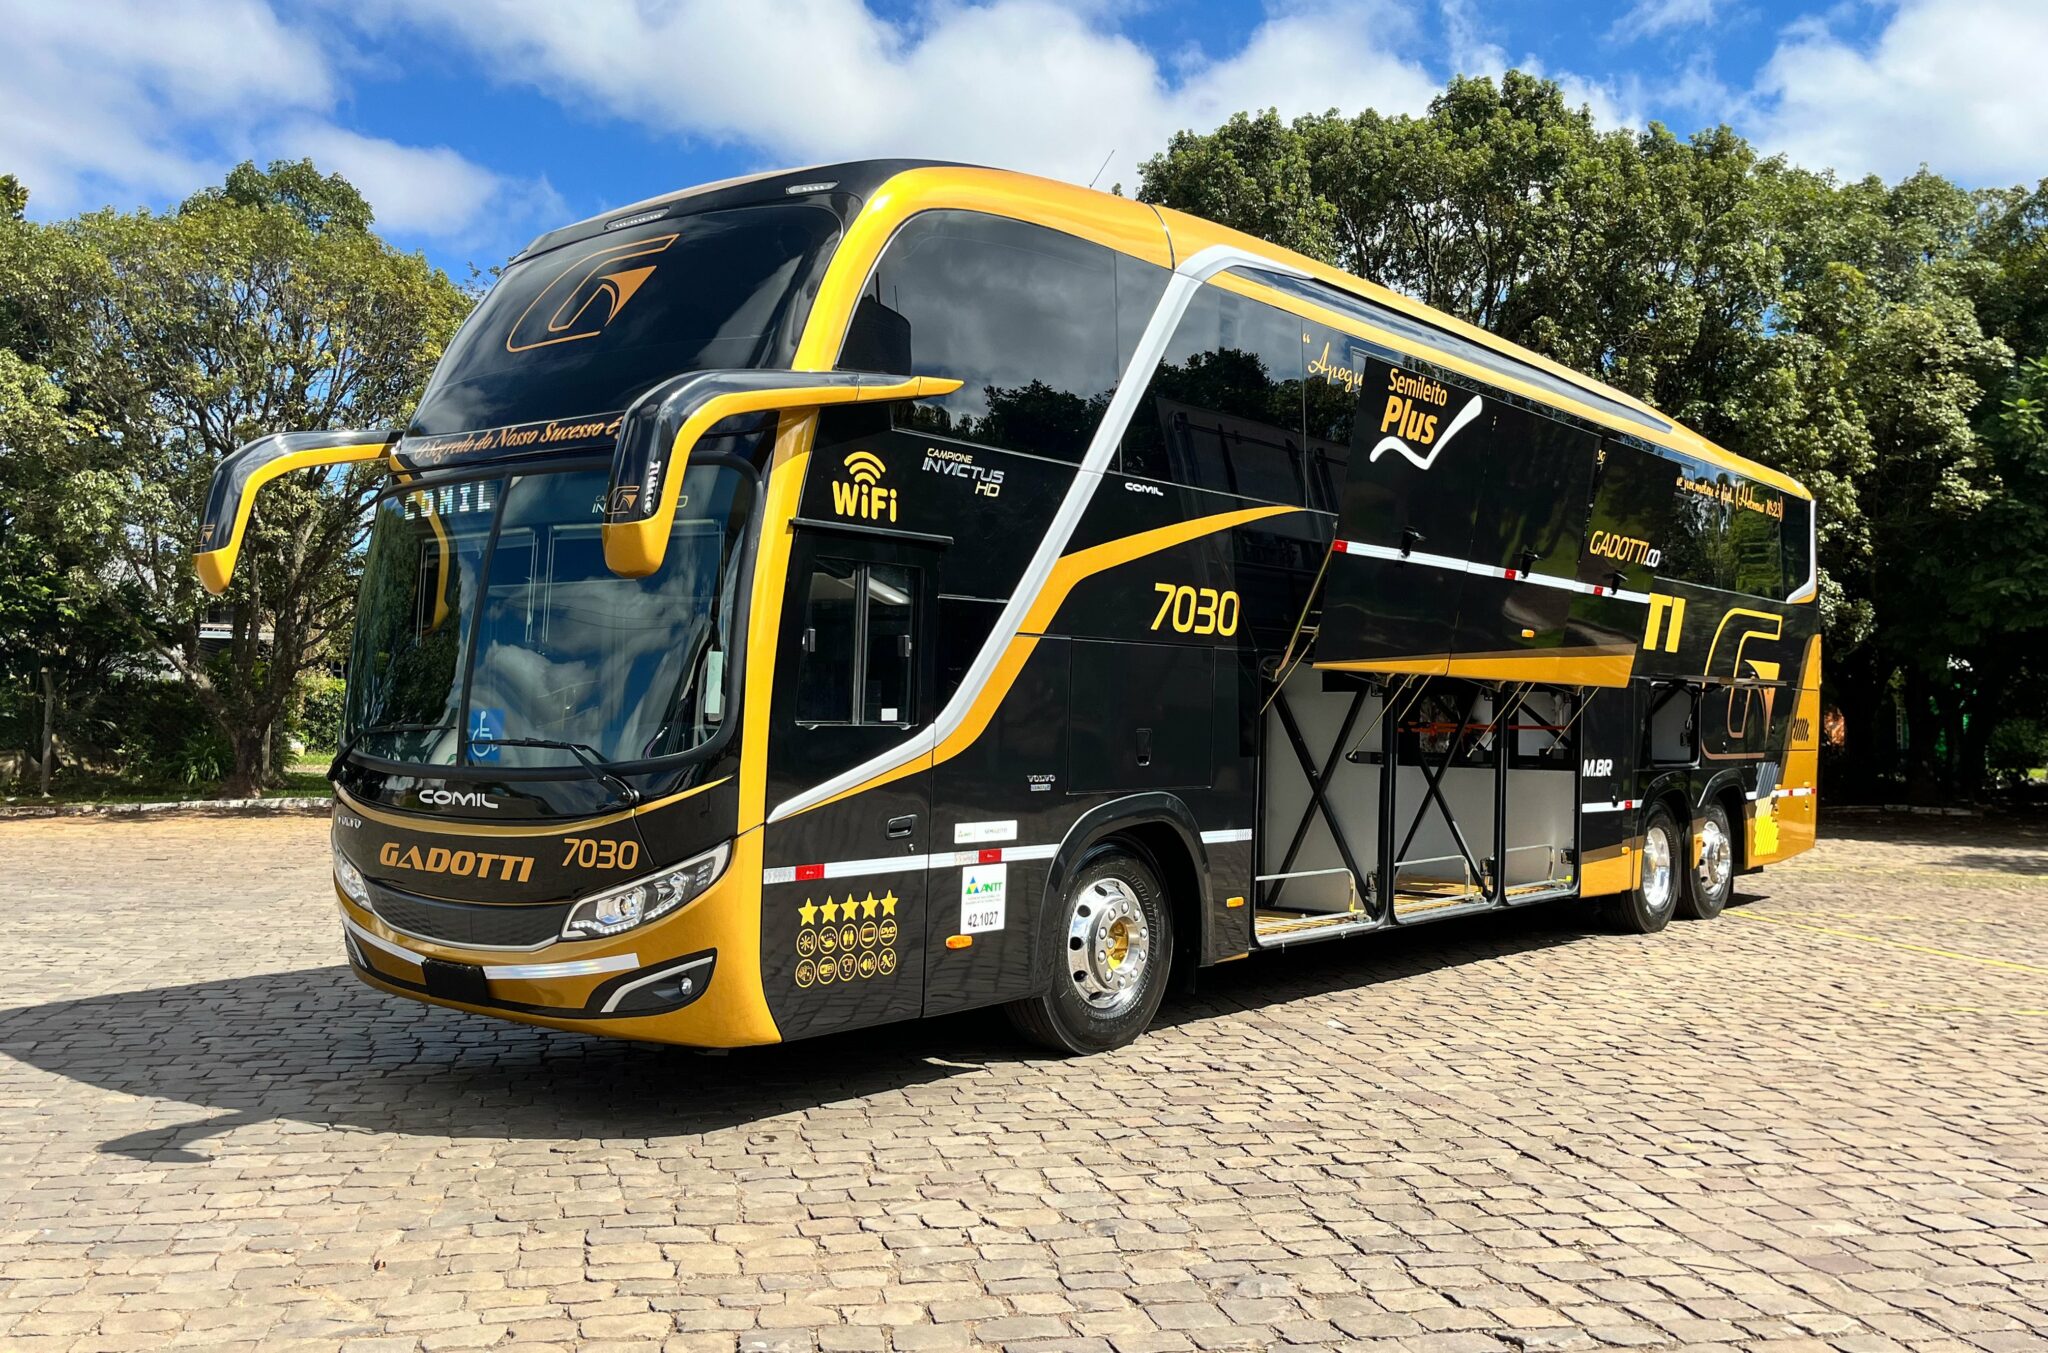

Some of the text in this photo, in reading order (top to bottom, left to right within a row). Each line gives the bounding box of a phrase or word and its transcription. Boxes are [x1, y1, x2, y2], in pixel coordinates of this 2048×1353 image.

[1388, 367, 1448, 407] Semileito
[1380, 395, 1438, 445] Plus
[472, 433, 494, 452] do
[491, 428, 539, 449] Nosso
[539, 421, 602, 443] Sucesso
[926, 448, 973, 464] CAMPIONE
[922, 457, 1005, 484] INVICTUS
[404, 481, 491, 520] COMIL
[974, 482, 1000, 498] HD
[1124, 482, 1164, 497] COMIL
[832, 481, 897, 523] WiFi
[1150, 582, 1240, 637] 7030
[1026, 774, 1056, 783] VOLVO
[1582, 758, 1613, 777] M.BR
[418, 789, 499, 809] COMIL
[338, 816, 362, 829] VOLVO
[379, 842, 534, 883] GADOTTI
[562, 838, 639, 870] 7030
[980, 882, 1003, 893] ANTT
[967, 911, 998, 928] 42.1027
